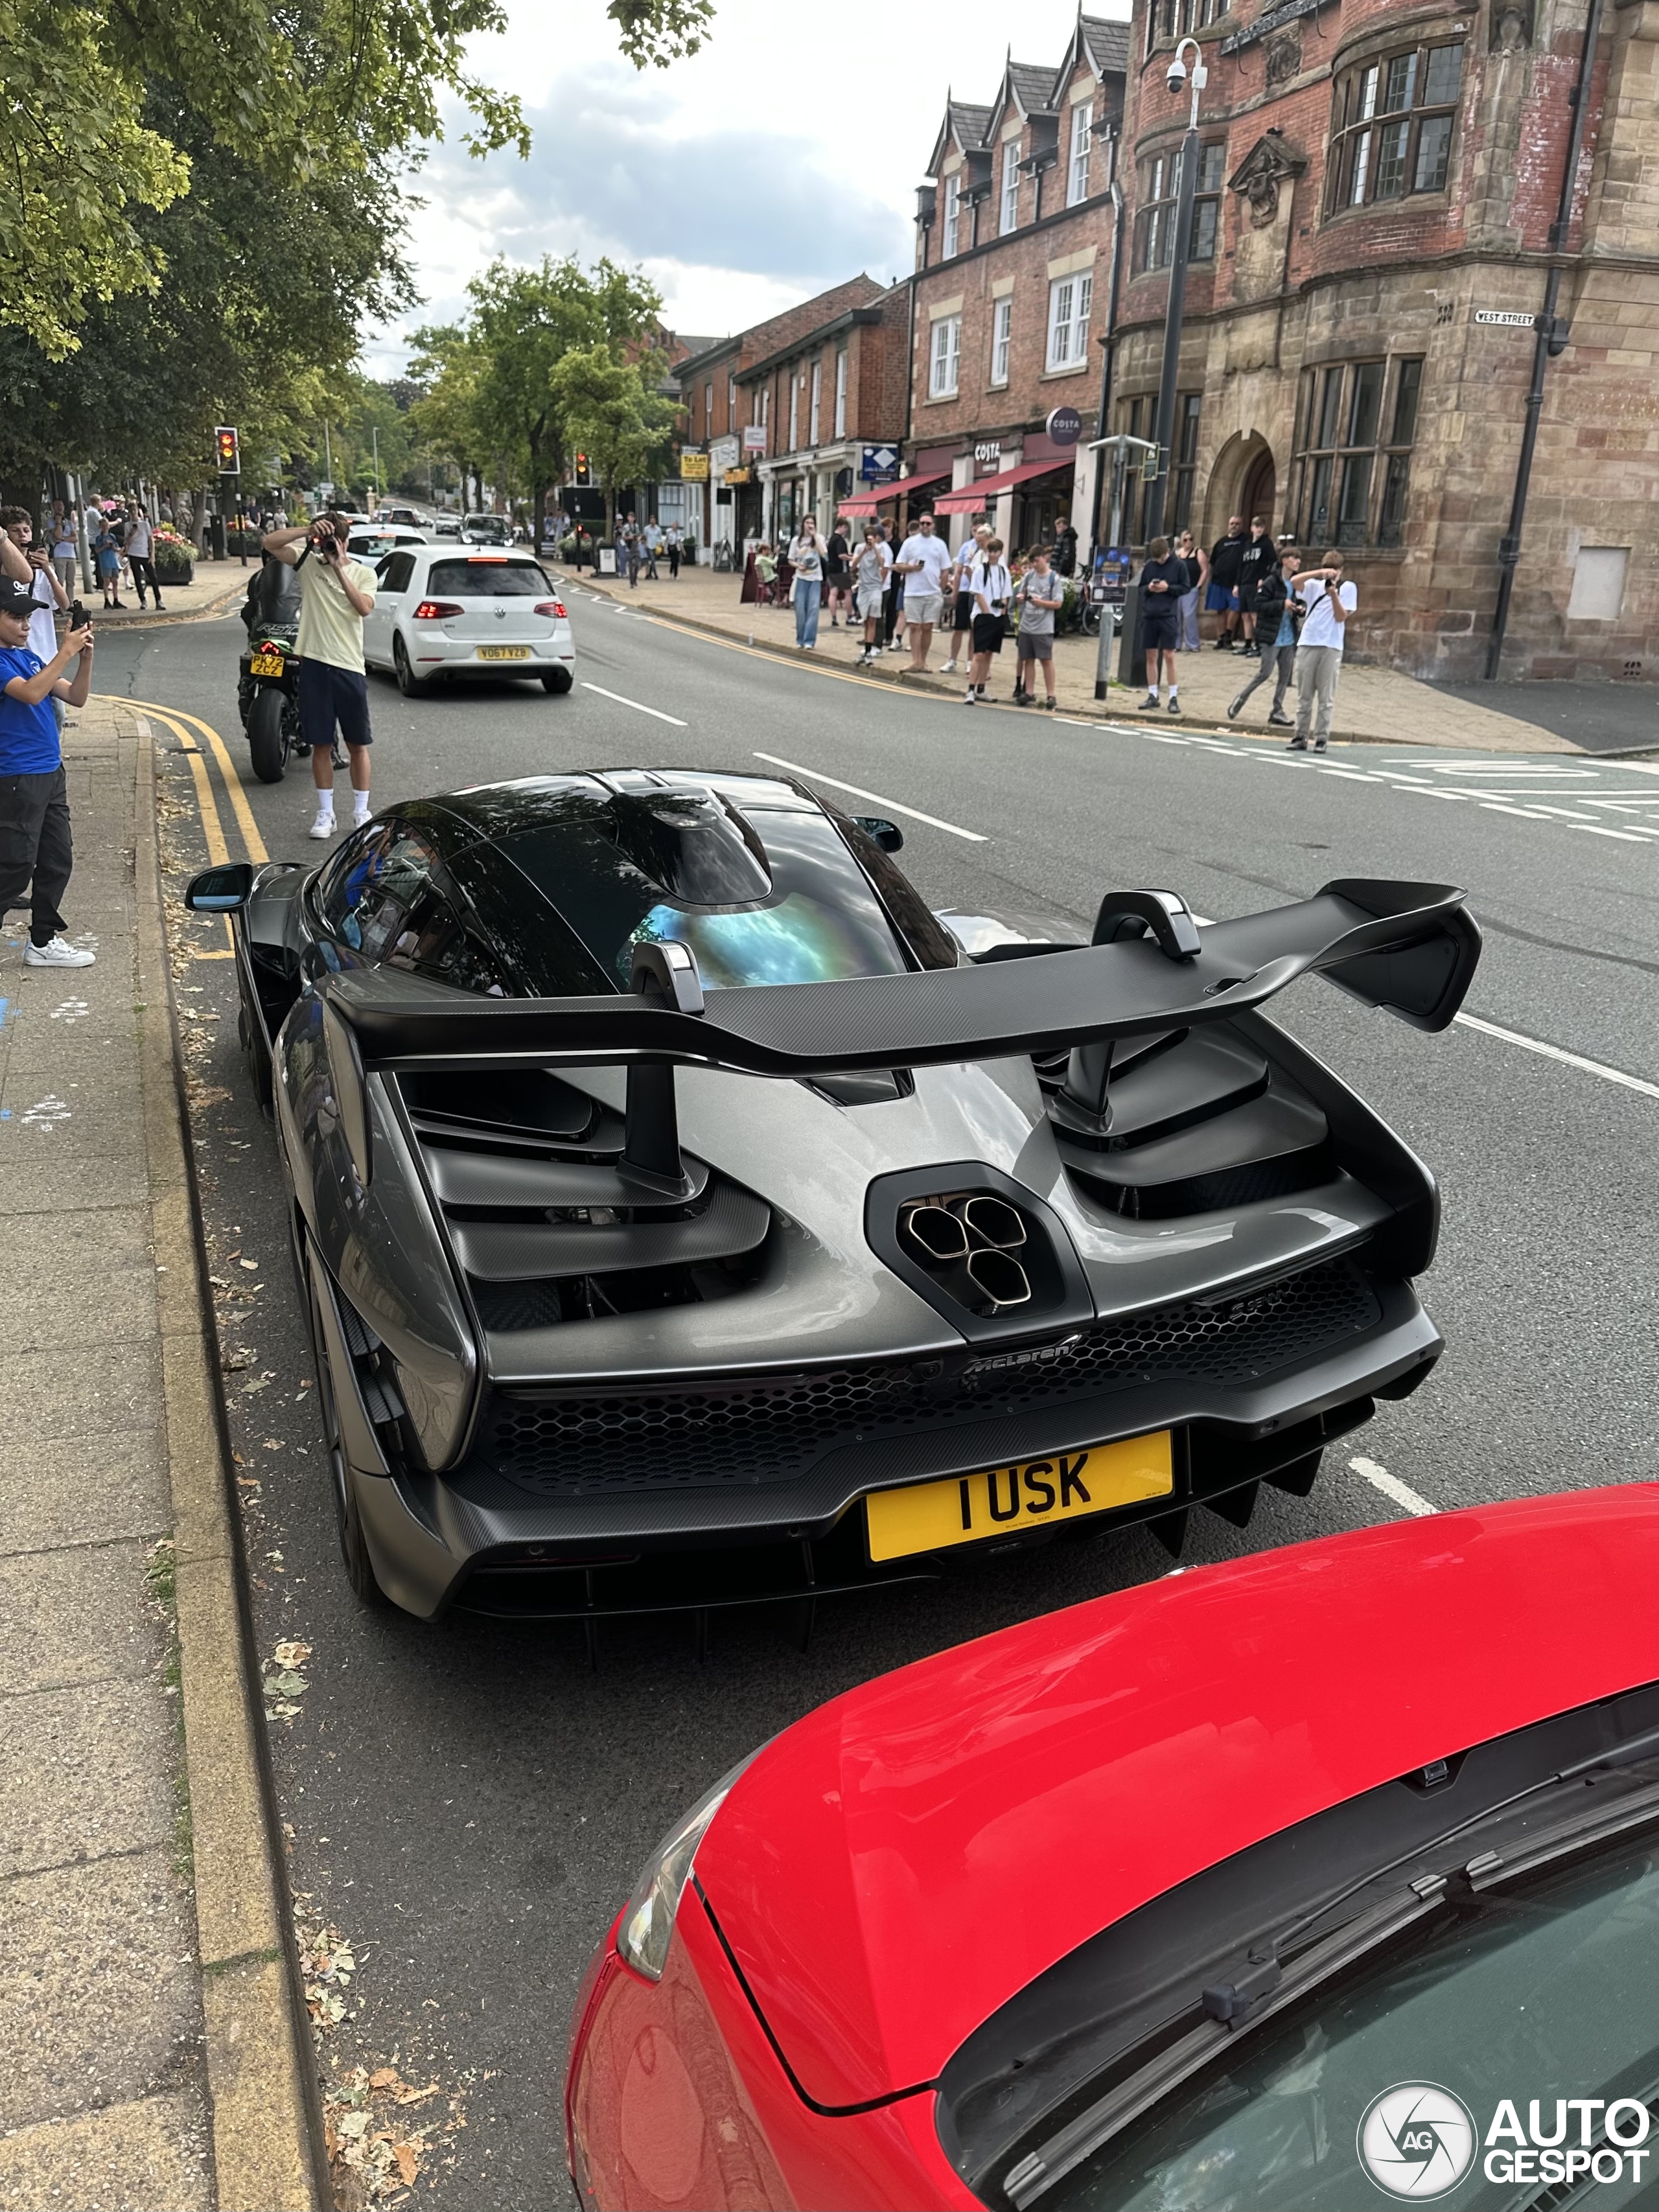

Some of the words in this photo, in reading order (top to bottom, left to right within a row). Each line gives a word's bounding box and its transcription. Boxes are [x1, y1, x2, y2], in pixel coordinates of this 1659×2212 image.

[1478, 313, 1500, 322] WEST
[1502, 314, 1533, 324] STREET
[1052, 420, 1080, 429] COSTA
[975, 442, 1001, 462] COSTA
[253, 655, 283, 667] PK72
[256, 664, 278, 675] ZCZ
[963, 1345, 1069, 1374] McLaren
[987, 1453, 1091, 1523] USK
